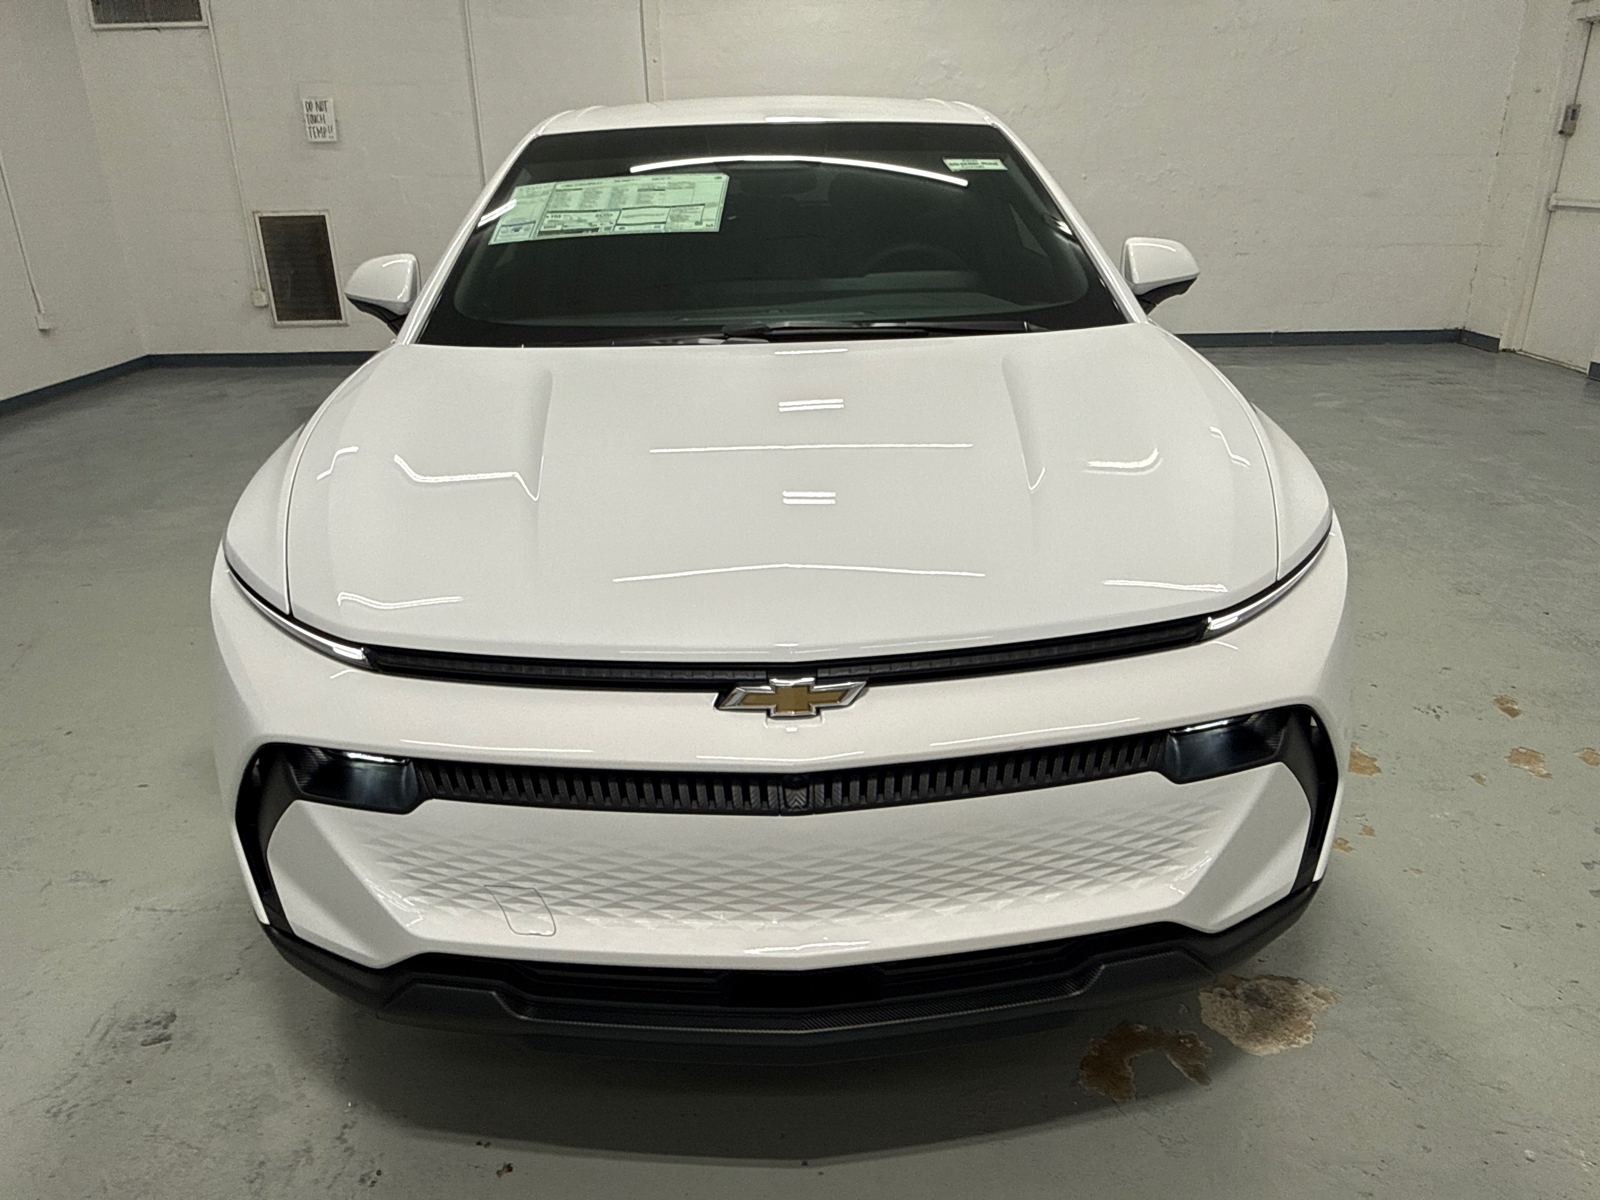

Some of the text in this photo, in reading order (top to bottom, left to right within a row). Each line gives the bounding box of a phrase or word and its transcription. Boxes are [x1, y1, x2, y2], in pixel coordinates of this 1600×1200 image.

[305, 100, 328, 112] DO NOT
[306, 114, 325, 125] TOUCH
